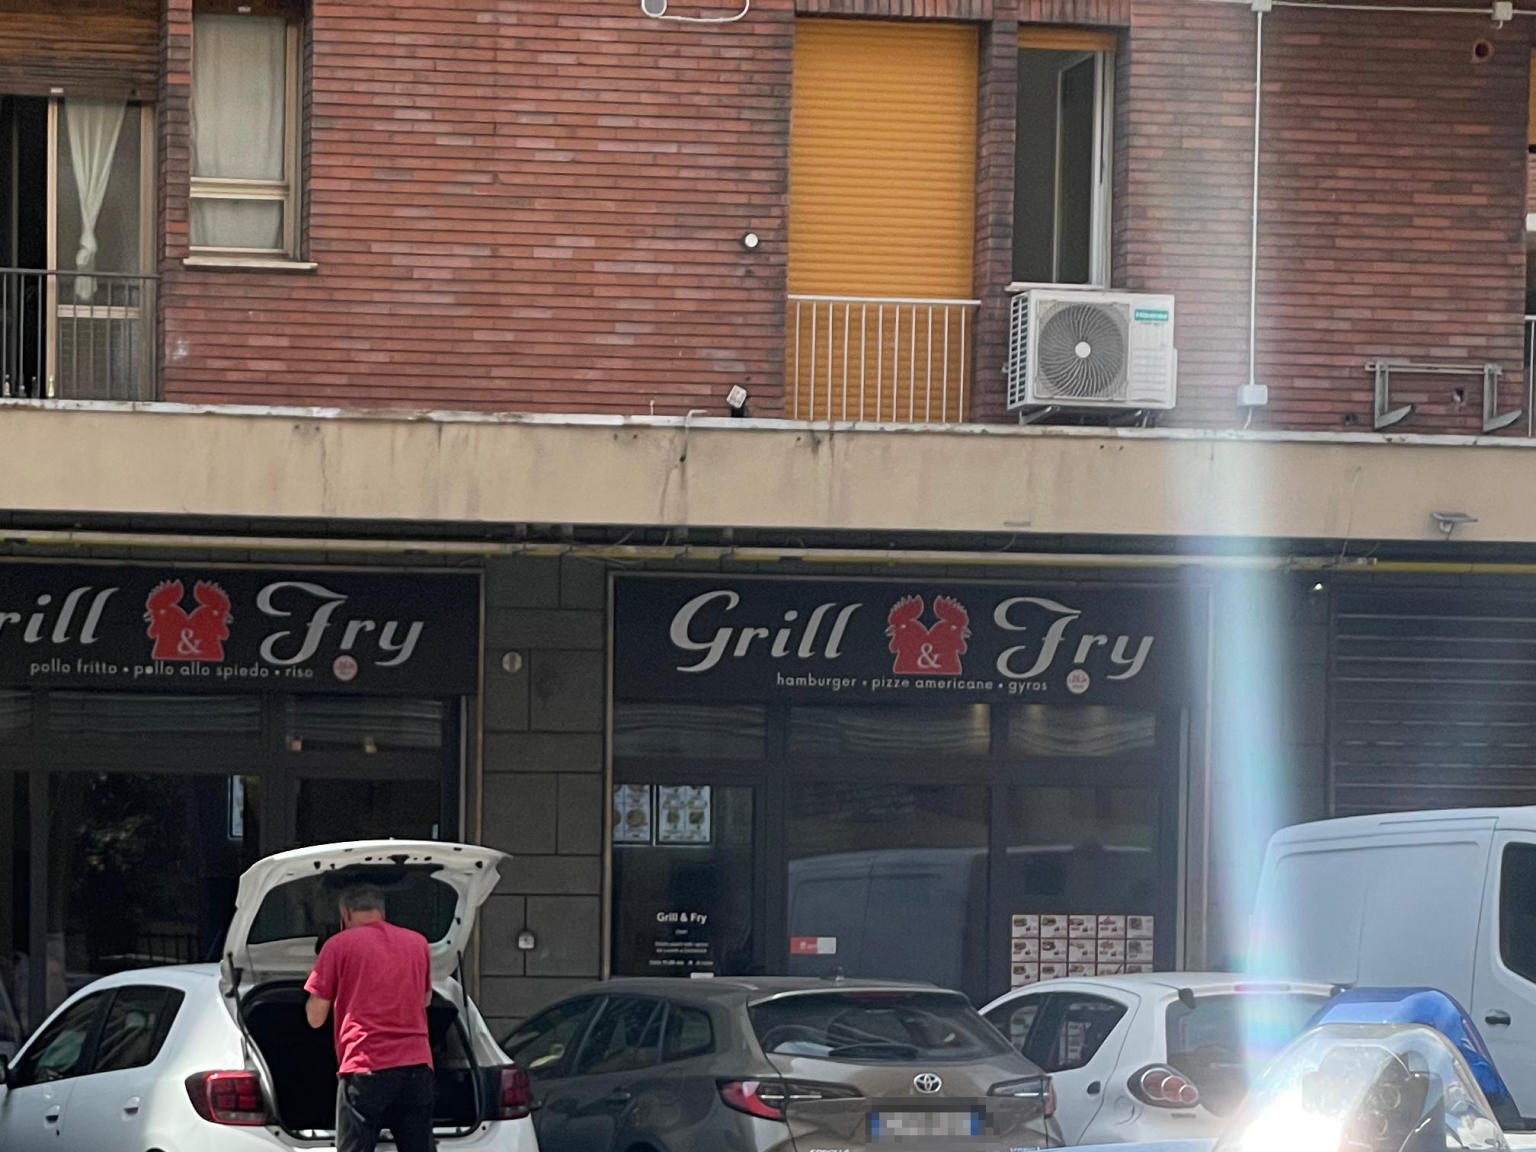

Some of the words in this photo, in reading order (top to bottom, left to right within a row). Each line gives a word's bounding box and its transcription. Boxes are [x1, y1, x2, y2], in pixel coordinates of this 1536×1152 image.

[177, 630, 201, 655] &
[256, 581, 425, 667] Fry
[670, 589, 863, 673] Grill
[917, 643, 942, 669] &
[993, 596, 1156, 680] Fry
[30, 659, 70, 676] pollo
[77, 659, 117, 674] fritto
[180, 661, 210, 676] allo
[216, 662, 269, 679] spiedo
[285, 664, 313, 678] riso
[776, 672, 856, 691] hamburger
[872, 675, 910, 691] pizze
[915, 677, 993, 690] americane
[1008, 680, 1048, 695] gyros
